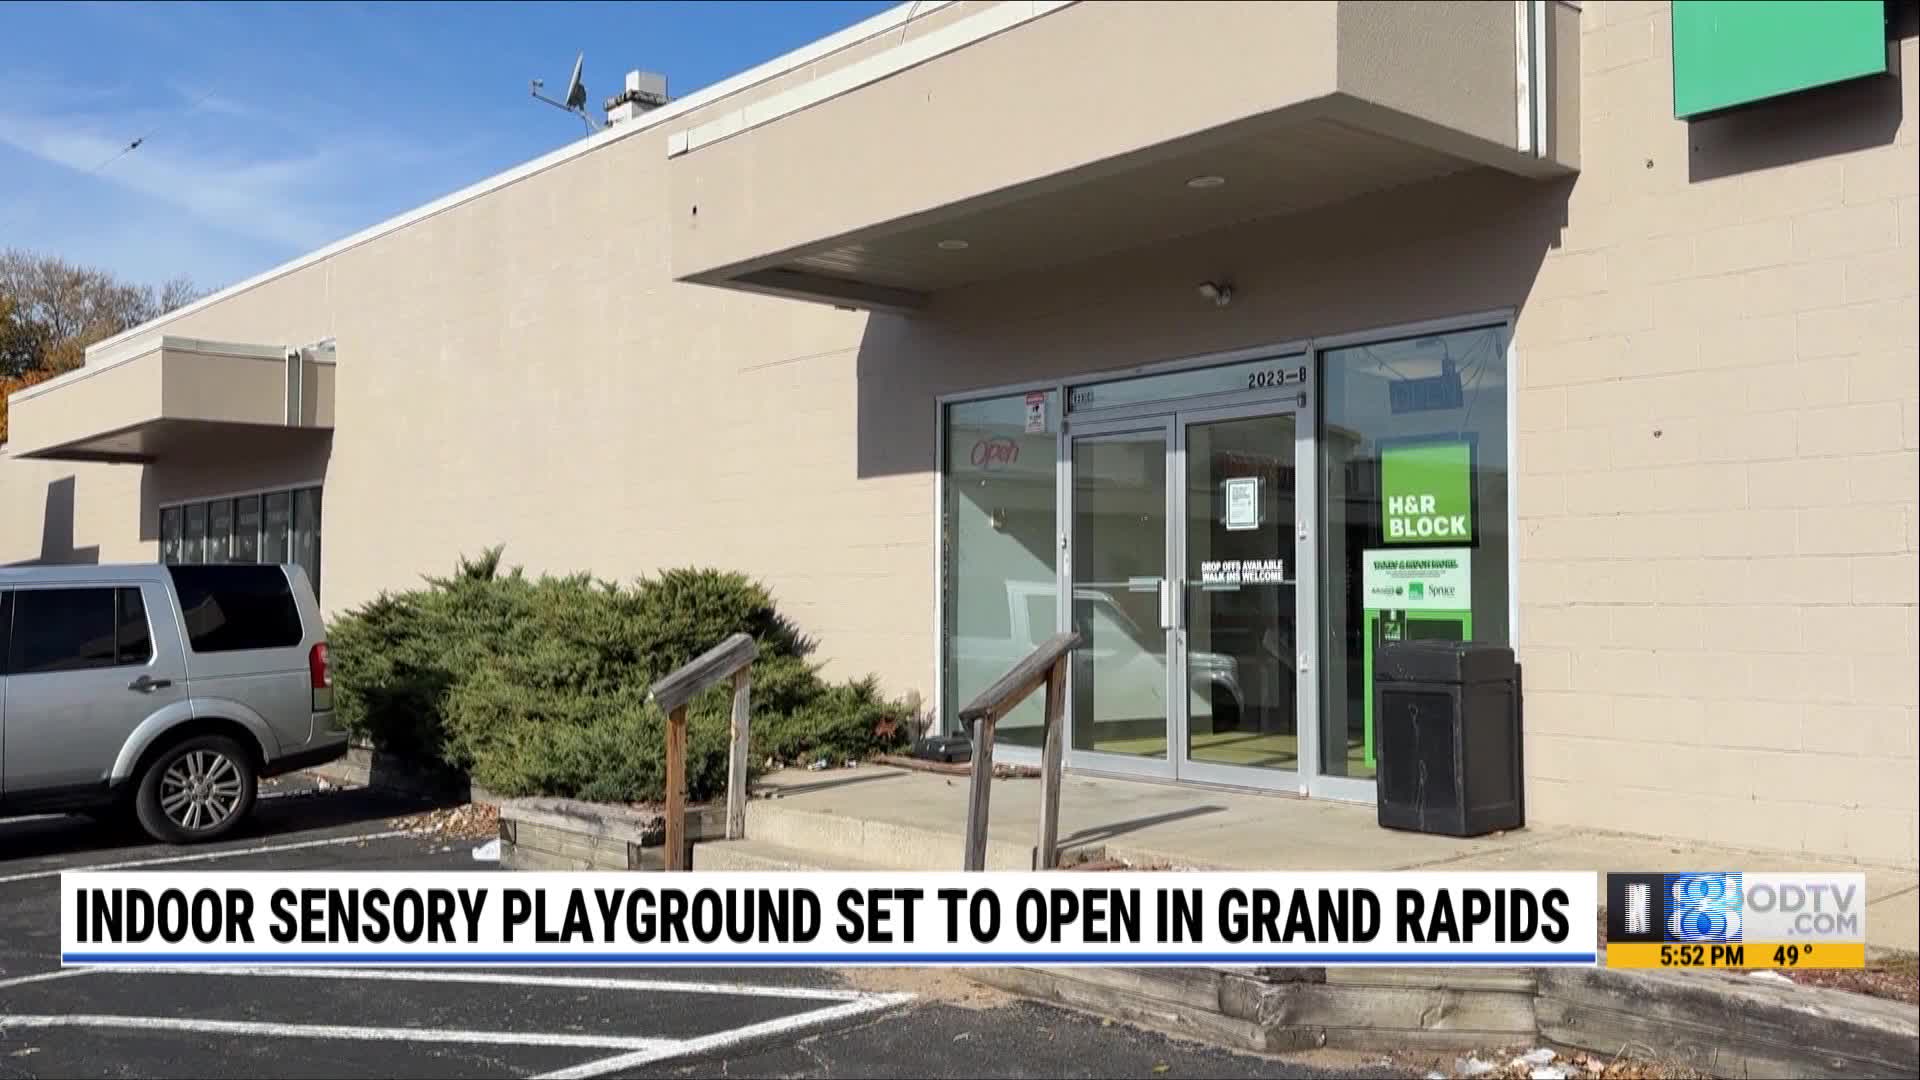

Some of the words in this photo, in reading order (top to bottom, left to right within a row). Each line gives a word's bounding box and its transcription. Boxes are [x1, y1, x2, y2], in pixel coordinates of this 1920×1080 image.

[971, 439, 1019, 467] Open
[1388, 494, 1436, 515] H&R
[1389, 515, 1466, 537] BLOCK
[1202, 561, 1221, 571] DROP
[1222, 560, 1240, 571] OFFS
[1242, 559, 1283, 571] AVAILABLE
[1203, 571, 1225, 582] WALK
[1226, 571, 1240, 582] INS
[1242, 571, 1283, 582] WELCOME
[1428, 584, 1456, 598] Spruce
